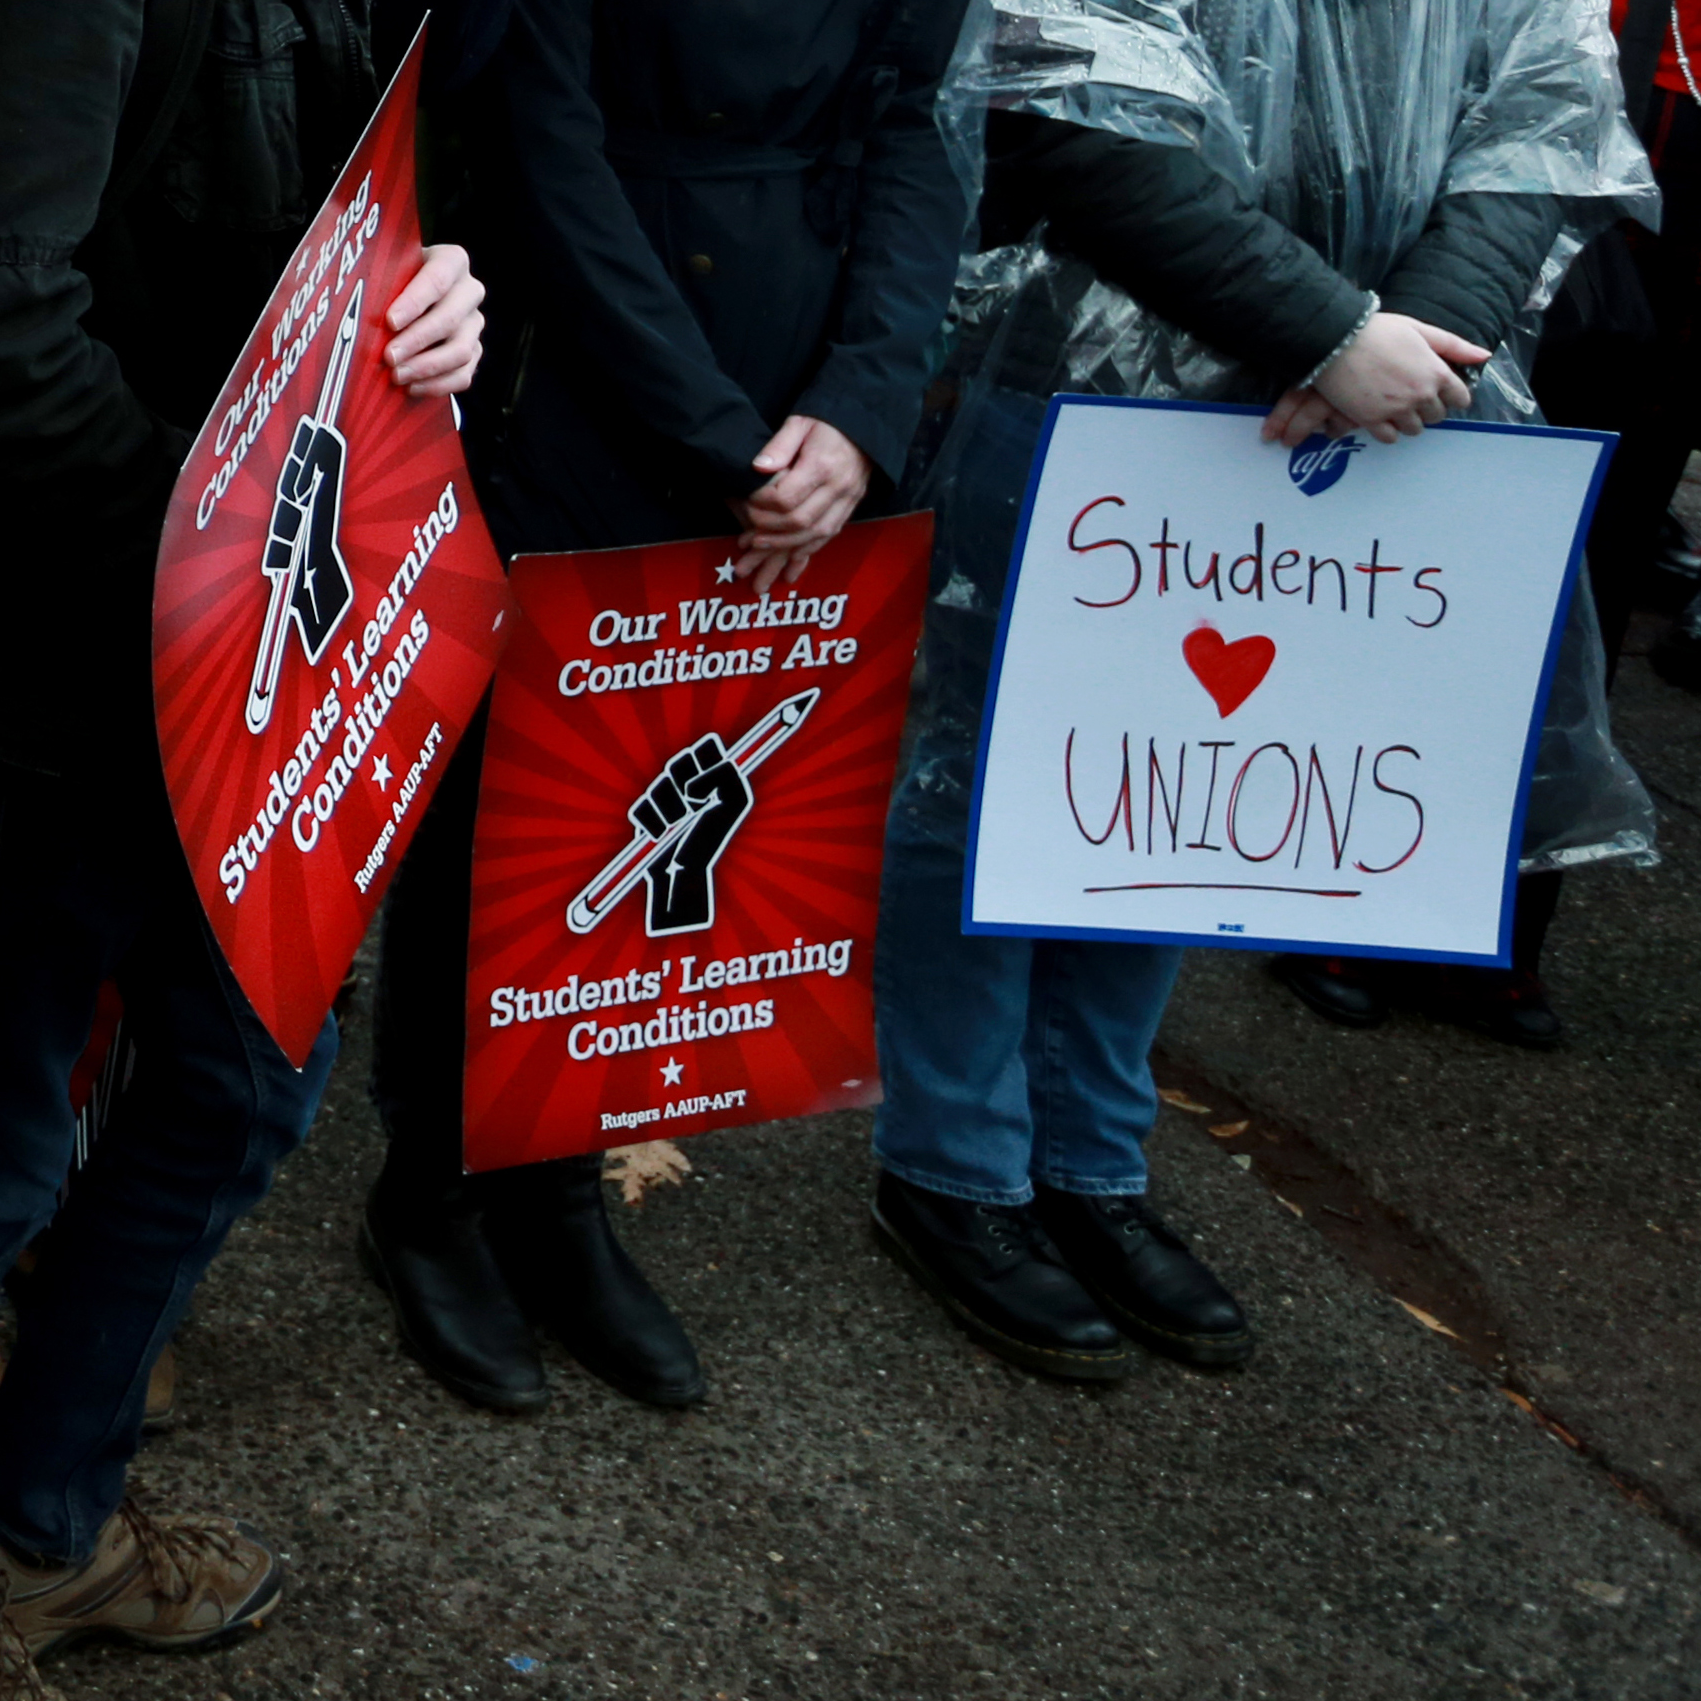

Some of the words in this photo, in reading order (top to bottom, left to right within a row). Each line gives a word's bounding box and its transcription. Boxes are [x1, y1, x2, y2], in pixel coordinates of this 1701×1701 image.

[196, 286, 330, 531] Conditions
[336, 201, 380, 294] Are
[214, 359, 265, 458] Our
[270, 169, 372, 359] Working
[1291, 434, 1366, 487] aft
[589, 608, 667, 649] Our
[677, 591, 848, 640] Working
[1067, 495, 1449, 629] Students
[218, 667, 341, 904] Students'
[341, 480, 460, 689] Learning
[291, 610, 430, 854] Conditions
[557, 643, 771, 697] Conditions
[781, 634, 858, 672] Are
[354, 819, 396, 894] Rutgers
[392, 721, 444, 825] AAUP-AFT
[1064, 726, 1424, 873] UNIONS
[489, 960, 670, 1028] Students'
[679, 937, 853, 991] Learning
[567, 997, 775, 1062] Conditions
[600, 1106, 660, 1131] Rutgers
[664, 1088, 747, 1119] AAUP-AFT
